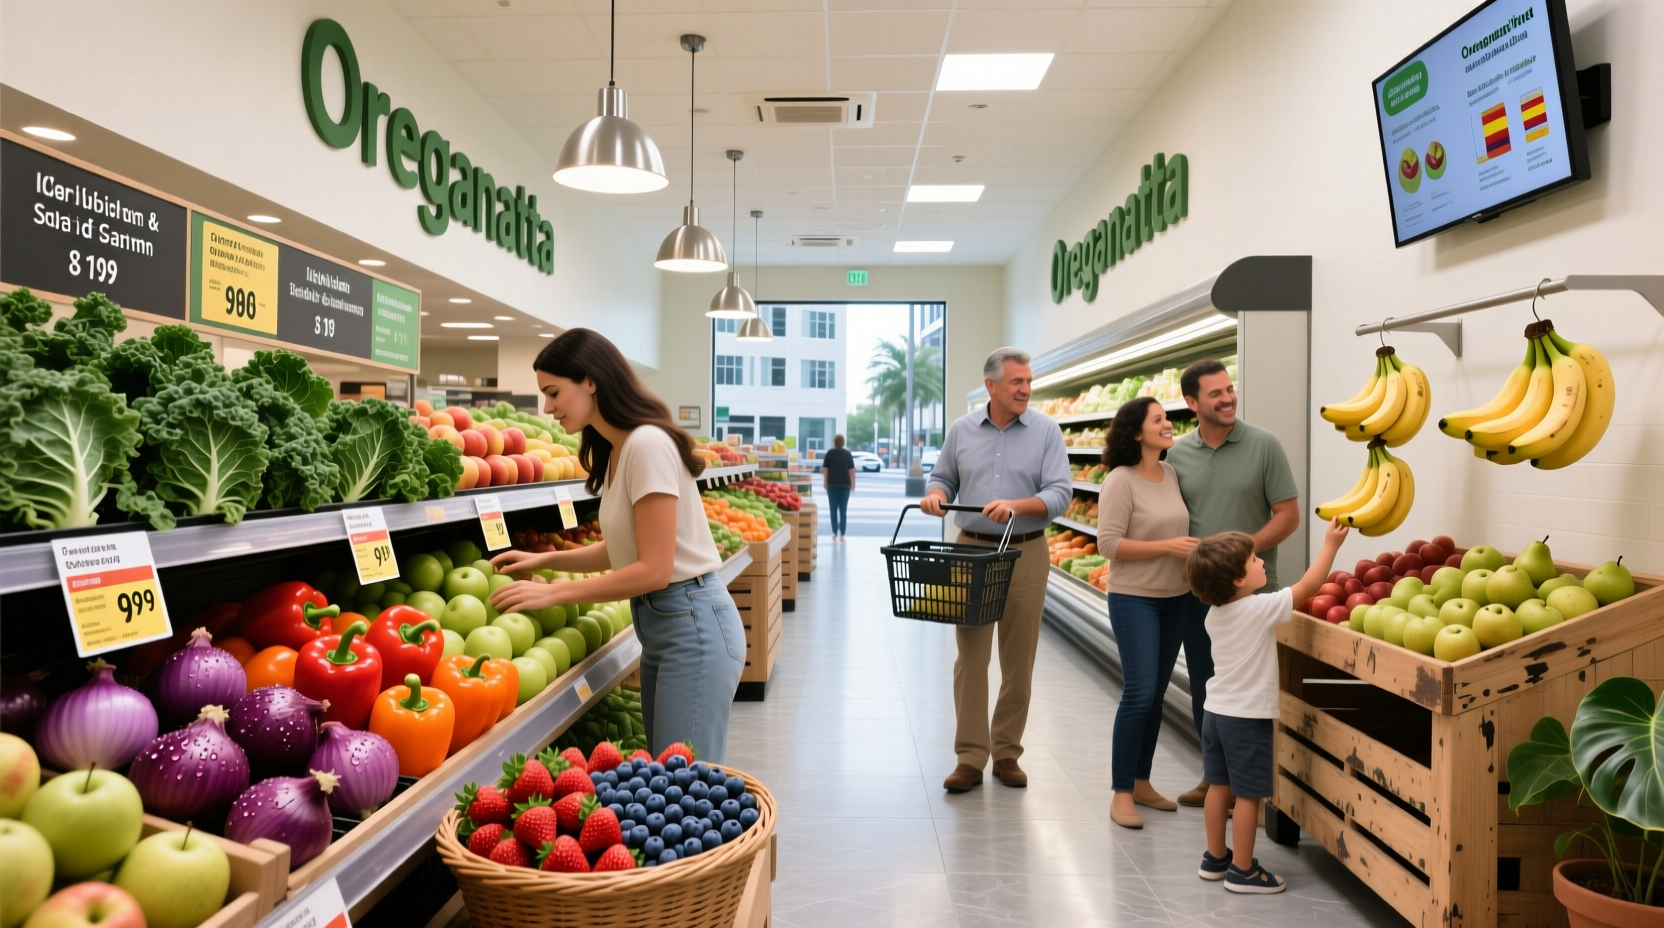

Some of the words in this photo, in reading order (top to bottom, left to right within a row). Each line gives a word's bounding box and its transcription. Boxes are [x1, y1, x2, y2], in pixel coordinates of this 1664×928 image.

[301, 18, 555, 275] Oreganatta
[148, 212, 159, 232] &
[1050, 152, 1189, 304] Oreganatta
[86, 255, 118, 285] 199
[117, 588, 155, 624] 999
